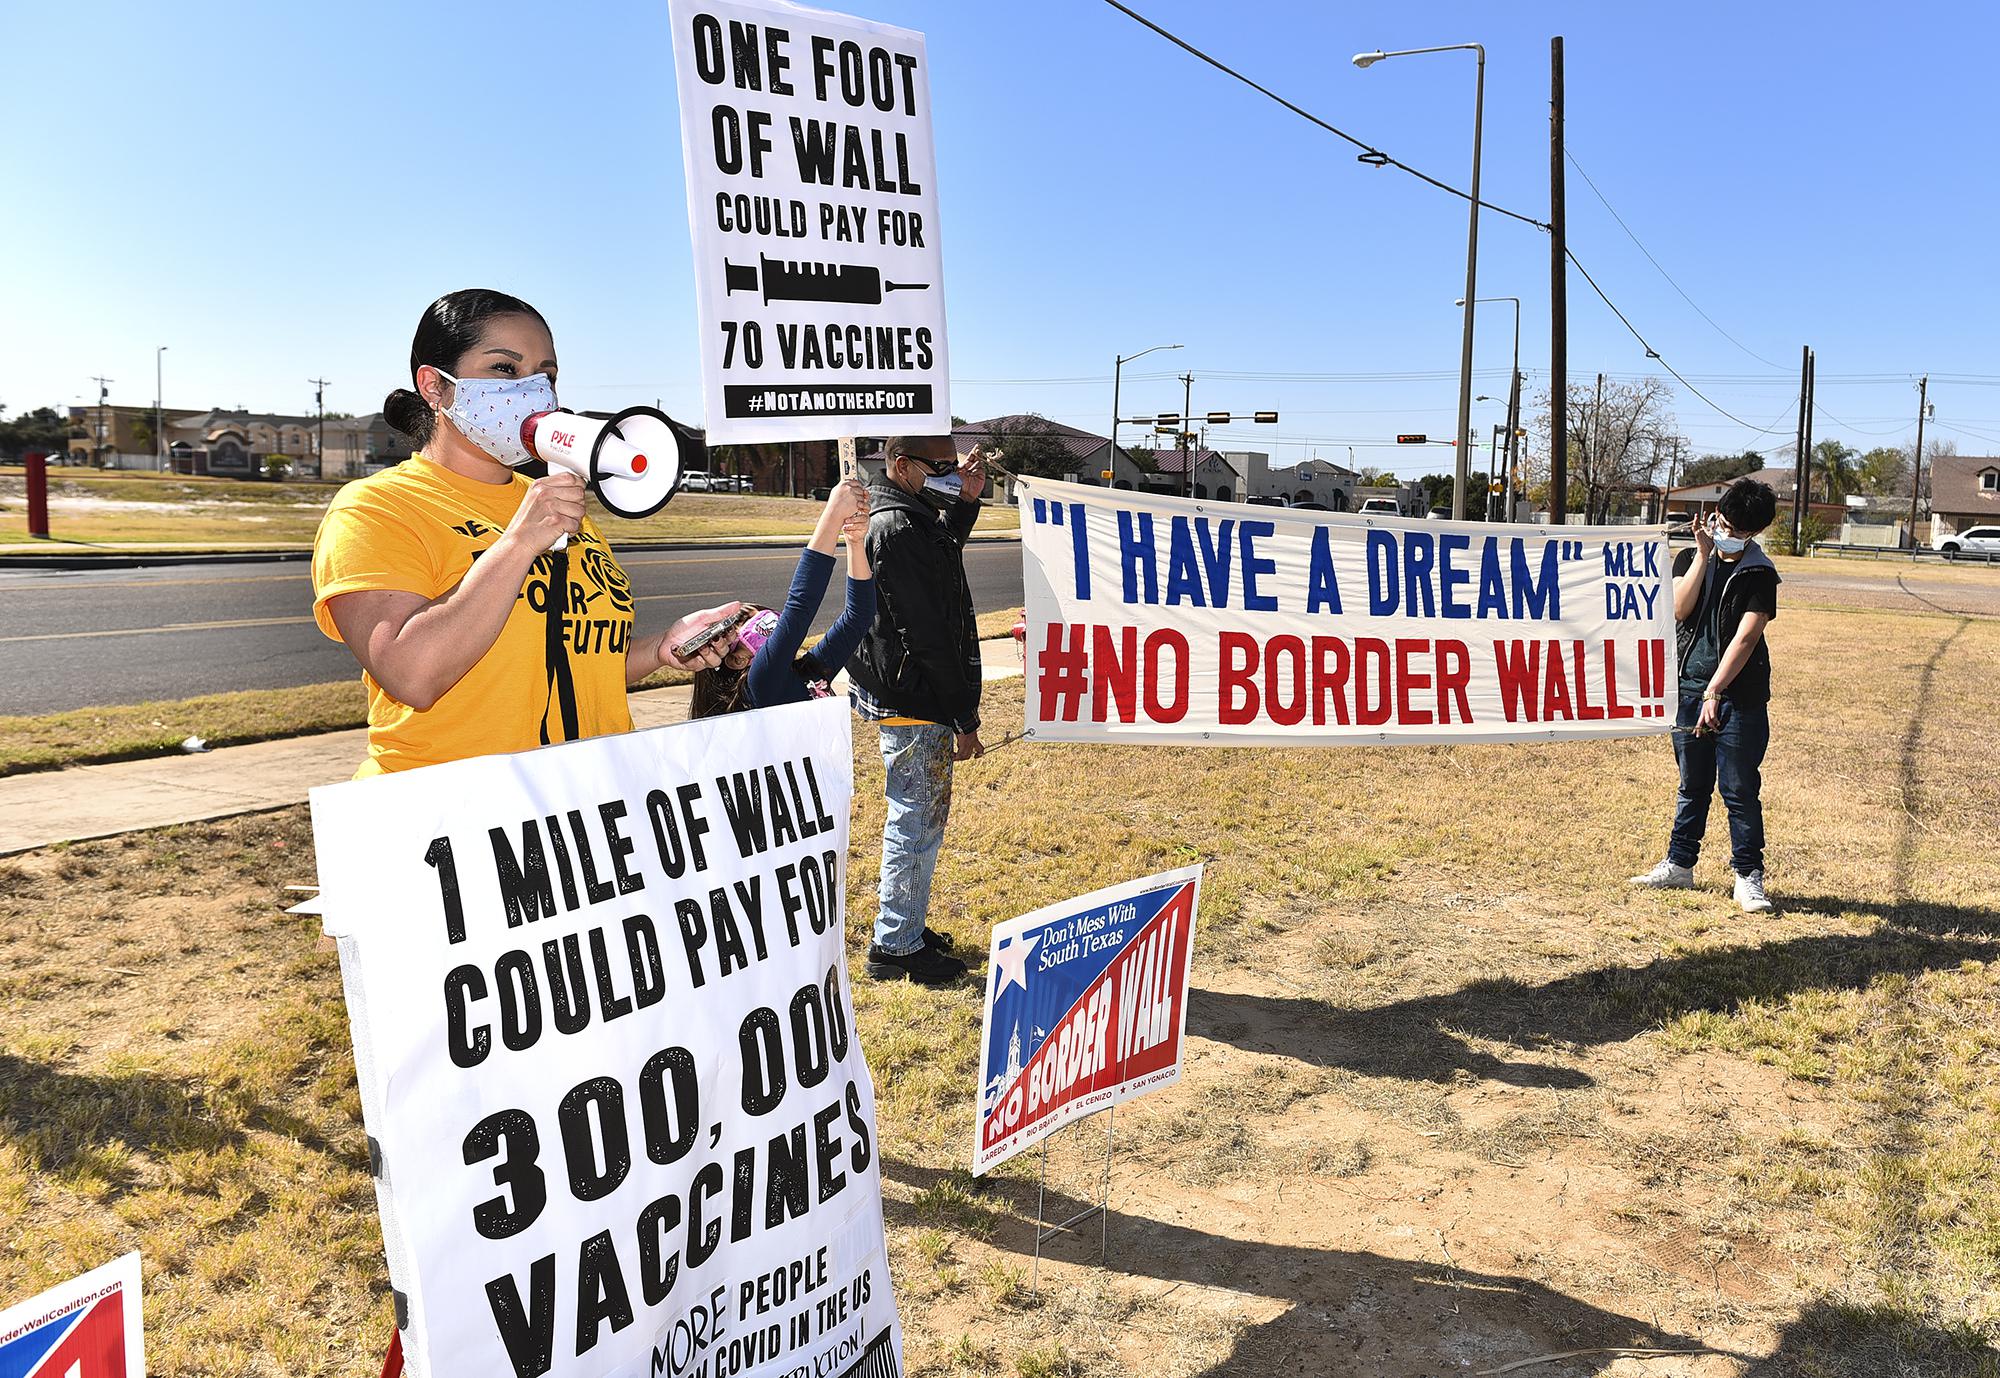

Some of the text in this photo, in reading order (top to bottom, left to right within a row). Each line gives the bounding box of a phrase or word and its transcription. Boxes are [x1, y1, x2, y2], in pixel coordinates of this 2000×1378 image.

[693, 13, 917, 117] ONE FOOT
[712, 104, 921, 196] OF WALL
[716, 191, 926, 249] COULD PAY FOR
[721, 321, 933, 371] 70 VACCINES
[551, 430, 575, 448] PYLE
[1117, 510, 1278, 612] HAVE
[1306, 526, 1344, 615] A
[1367, 529, 1583, 621] DREAM"
[1602, 541, 1659, 579] MLK
[1605, 583, 1659, 621] DAY
[1038, 622, 1665, 726] #NO BORDER WALL!!
[424, 756, 835, 944] 1 MILE OF WALL
[444, 849, 837, 1069] COULD PAY FOR
[1038, 929, 1124, 972] South Texas
[1042, 903, 1137, 949] Don't Mess With
[988, 907, 1179, 1142] NO BORDER WALL
[981, 1069, 1176, 1164] LAREDO RIO BRAVO EL CENIZO SAN YGNACIO
[484, 1080, 871, 1378] VACCINES
[0, 1280, 123, 1345] rderWallCoalition.com
[651, 1246, 827, 1378] MORE PEOPLE
[715, 1324, 780, 1378] COVID
[790, 1310, 810, 1350] IN
[816, 1286, 847, 1336] THE
[853, 1269, 871, 1311] US
